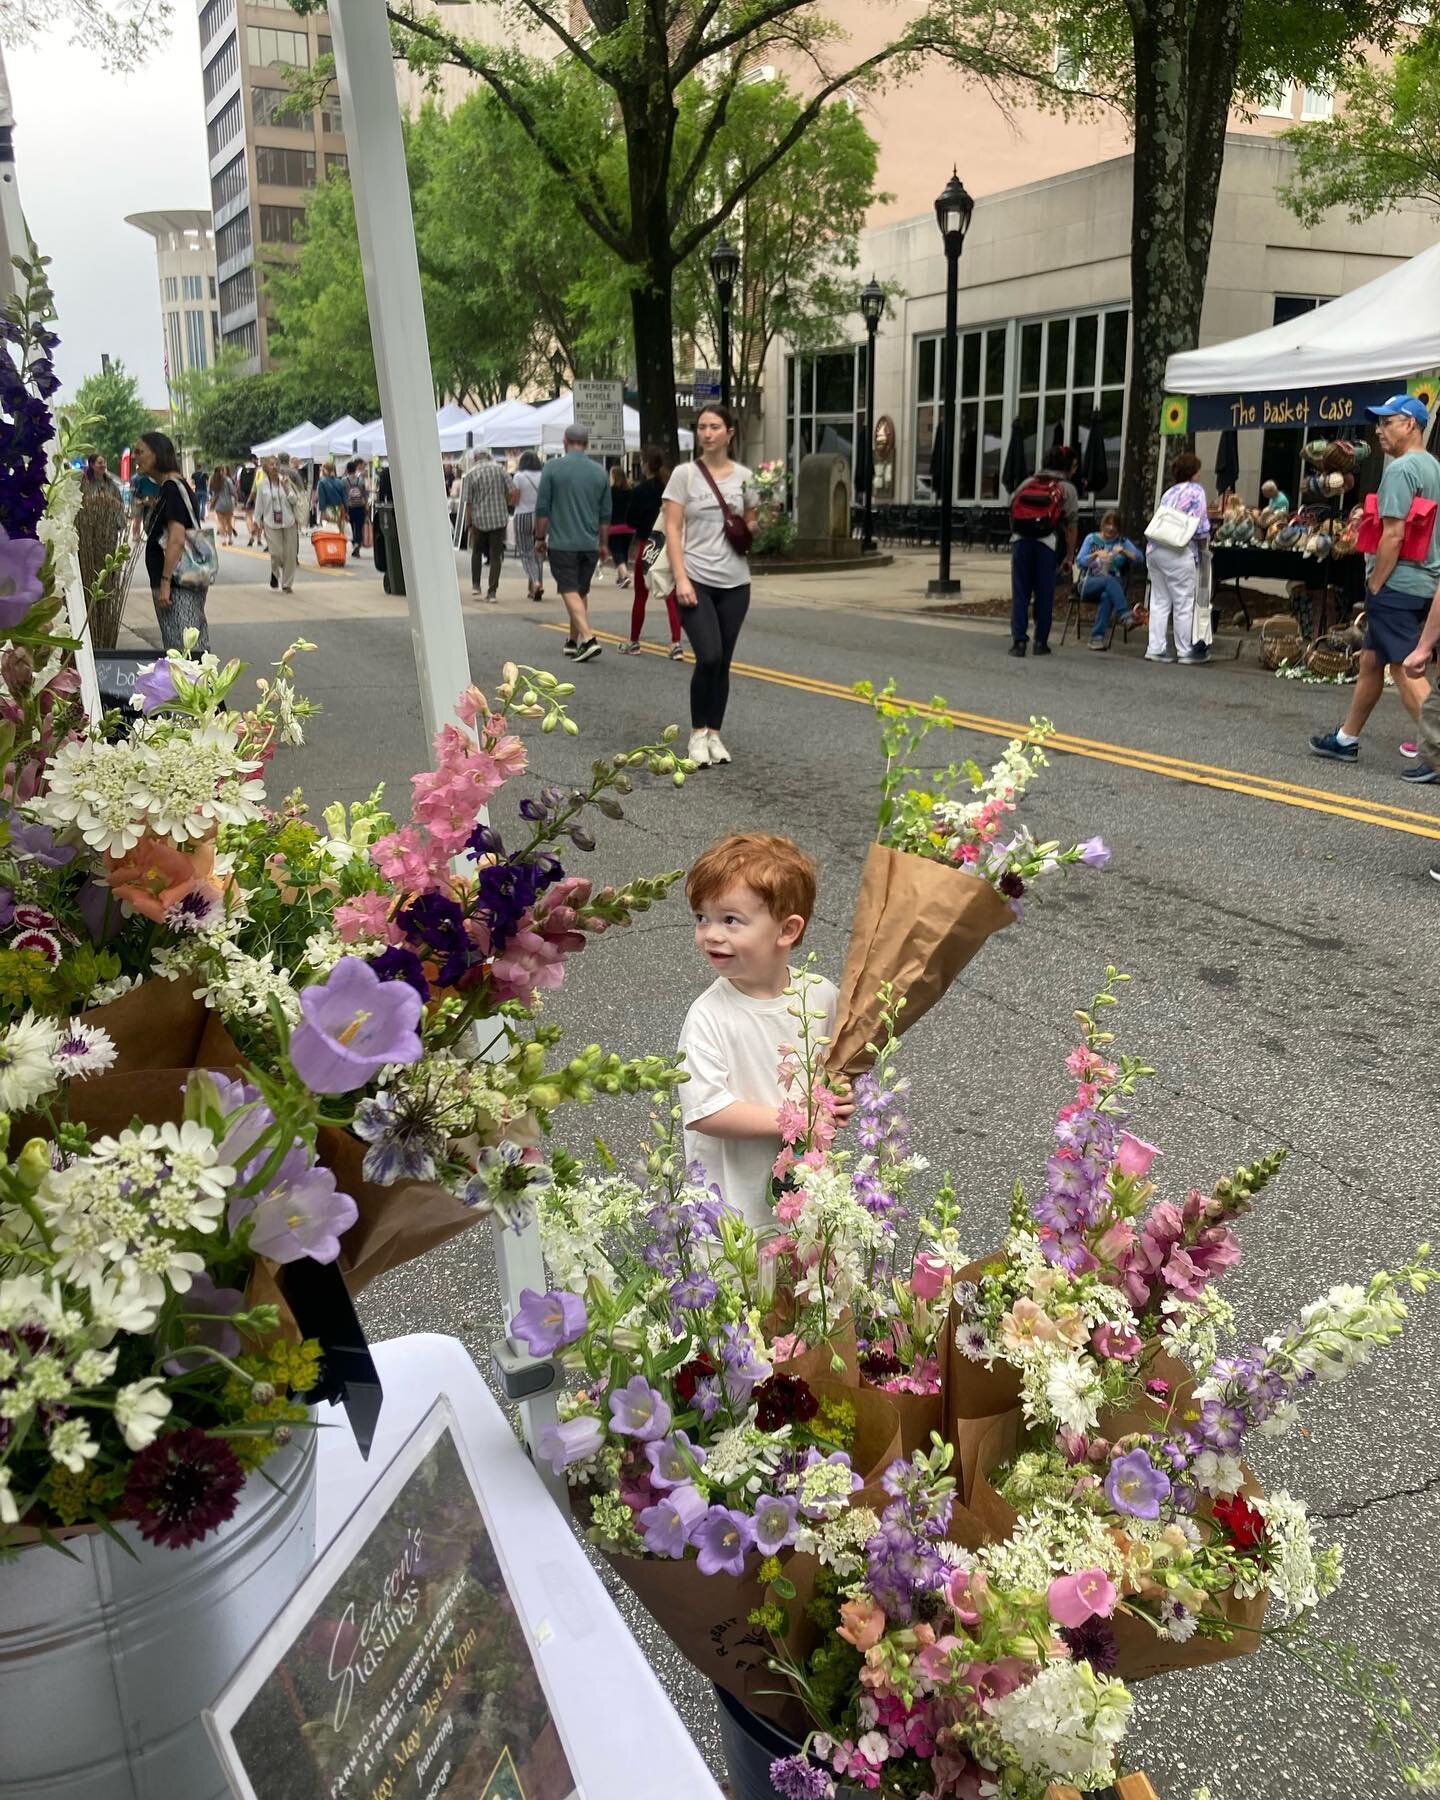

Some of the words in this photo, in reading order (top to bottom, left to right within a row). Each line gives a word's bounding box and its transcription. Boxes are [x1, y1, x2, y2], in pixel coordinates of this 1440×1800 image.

[1230, 394, 1256, 428] The
[1263, 395, 1311, 425] Basket
[1319, 395, 1353, 421] Case
[330, 1687, 399, 1800] FARM-TO-TABLE
[398, 1645, 425, 1690] DINING
[423, 1574, 467, 1647] EXPERIENCE
[363, 1752, 375, 1777] AT
[375, 1701, 406, 1755] RABBIT
[406, 1659, 431, 1703] CREST
[430, 1619, 455, 1663] FARMS
[394, 1723, 420, 1772] May
[420, 1687, 443, 1728] 21st
[442, 1666, 454, 1690] at
[450, 1628, 478, 1670] 7pm
[416, 1714, 454, 1789] featuring
